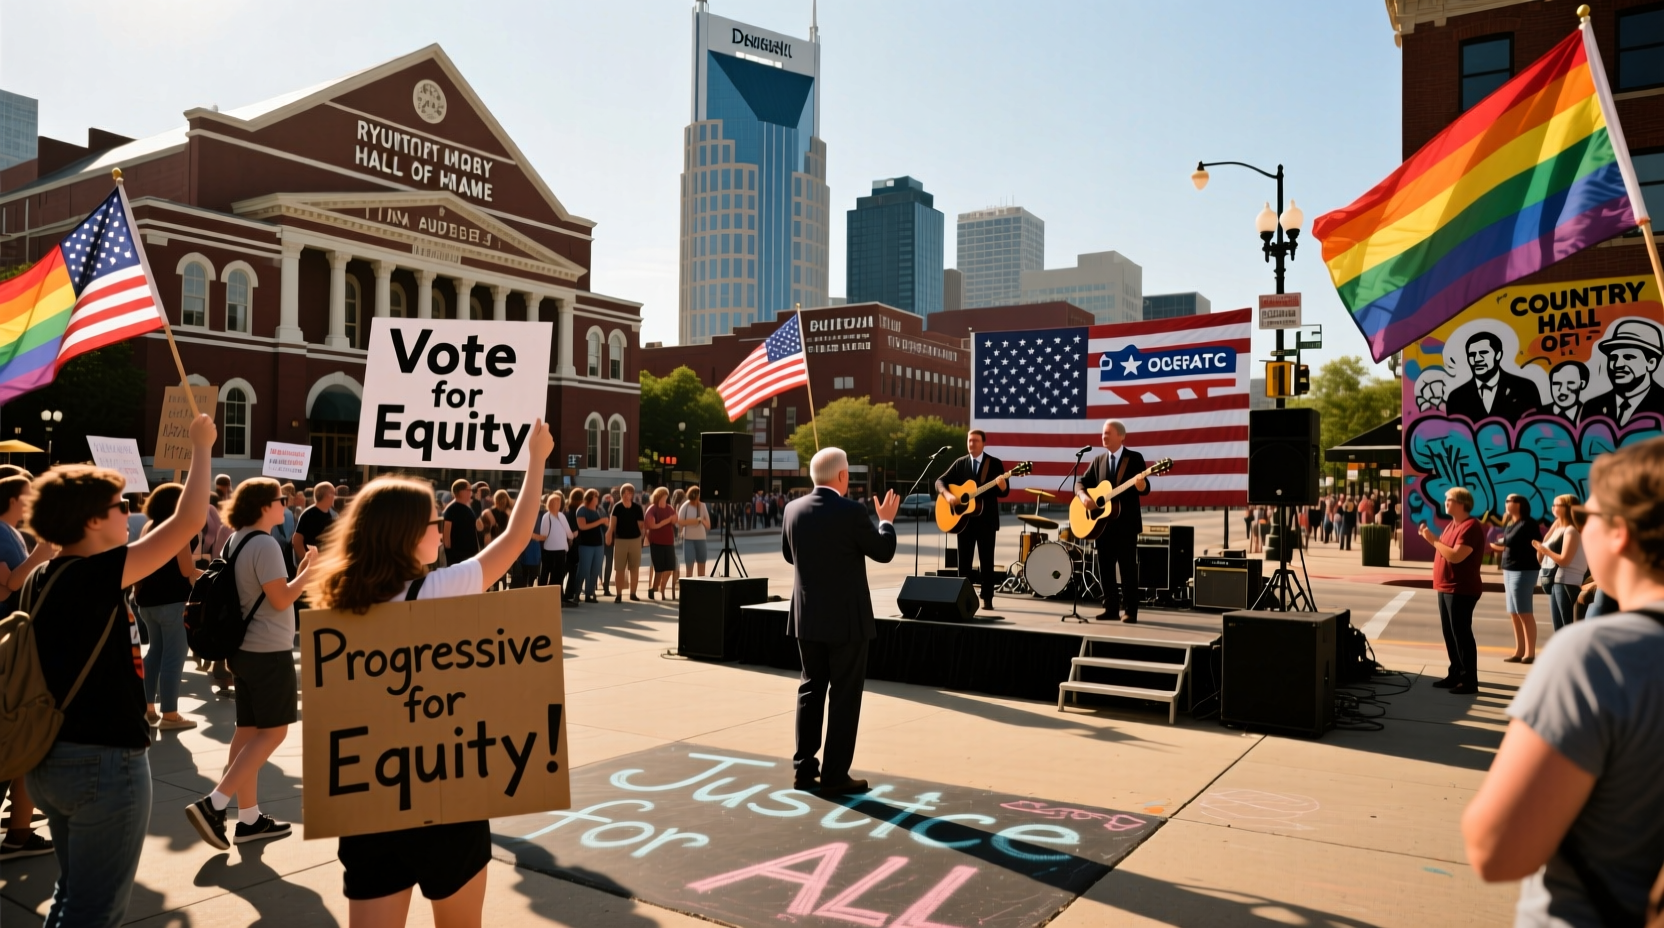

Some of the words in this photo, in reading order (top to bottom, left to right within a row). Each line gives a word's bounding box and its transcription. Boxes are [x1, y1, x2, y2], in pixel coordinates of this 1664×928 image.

[355, 145, 403, 177] HALL
[411, 161, 433, 184] OF
[1510, 281, 1646, 317] COUNTRY
[1538, 308, 1601, 334] HALL
[390, 328, 516, 378] Vote
[431, 380, 483, 409] for
[374, 404, 531, 465] Equity
[313, 627, 554, 696] Progressive
[403, 685, 466, 723] for
[328, 703, 563, 811] Equity!
[508, 800, 710, 858] for
[685, 841, 979, 928] ALL
